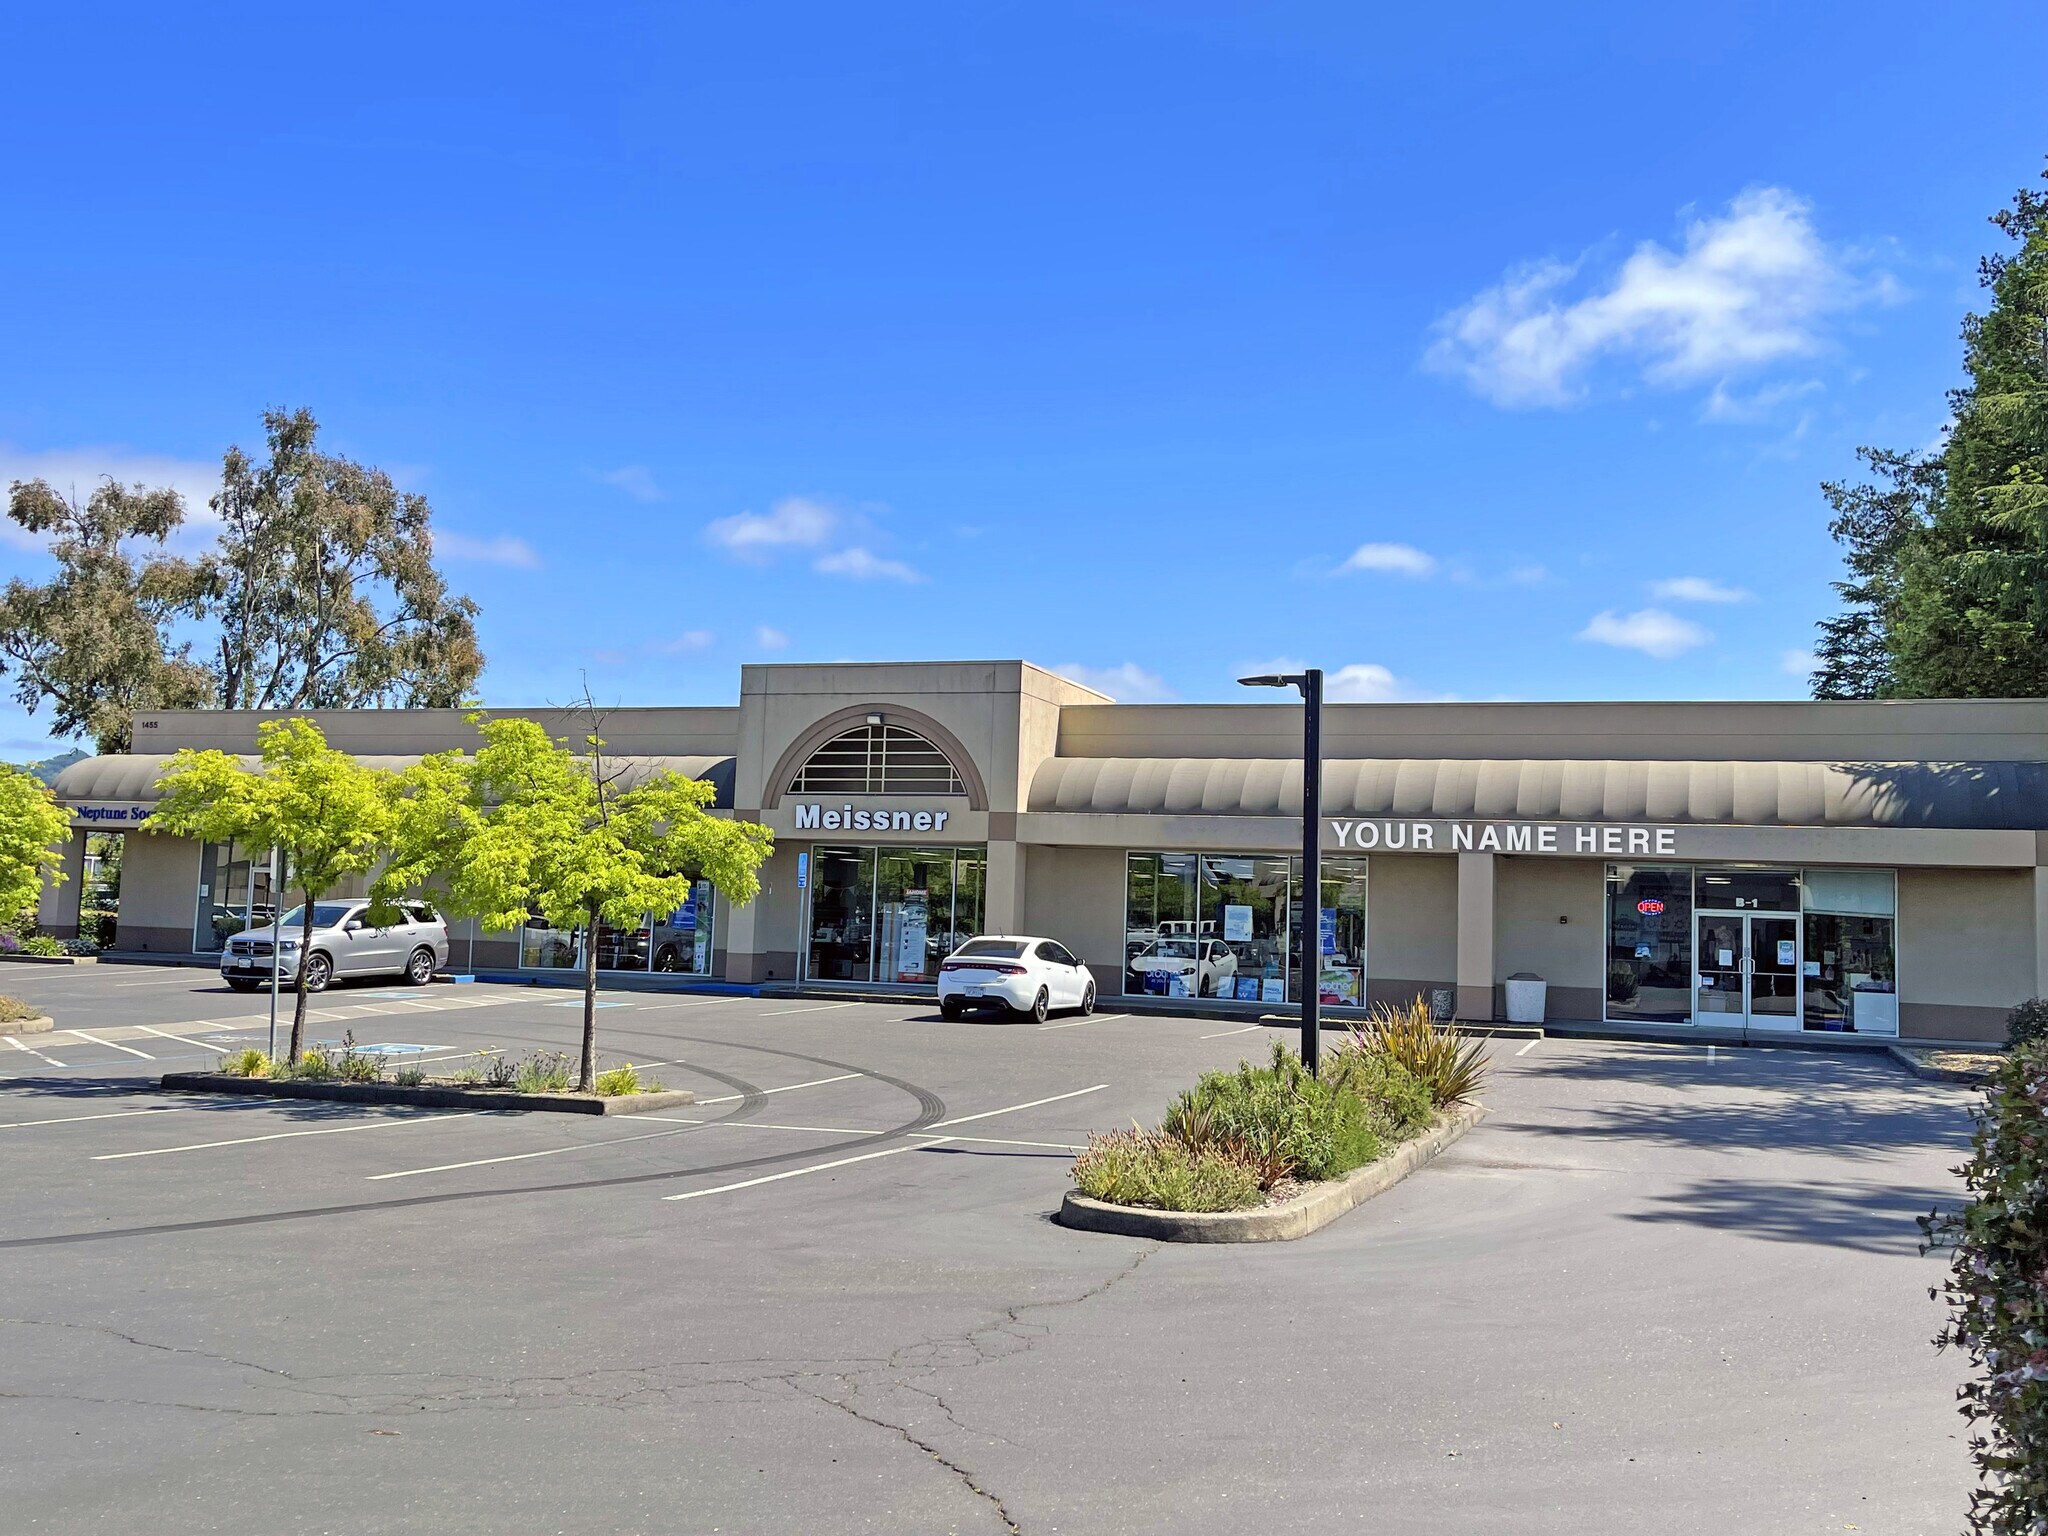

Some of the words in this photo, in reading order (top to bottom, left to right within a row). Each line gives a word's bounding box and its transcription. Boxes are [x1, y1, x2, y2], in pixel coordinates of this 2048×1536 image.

[77, 806, 127, 821] Neptune
[795, 804, 948, 831] Meissner
[1331, 821, 1434, 849] YOUR
[1452, 824, 1557, 851] NAME
[1575, 827, 1676, 854] HERE
[1637, 902, 1664, 912] OPEN
[1736, 898, 1758, 908] B-1
